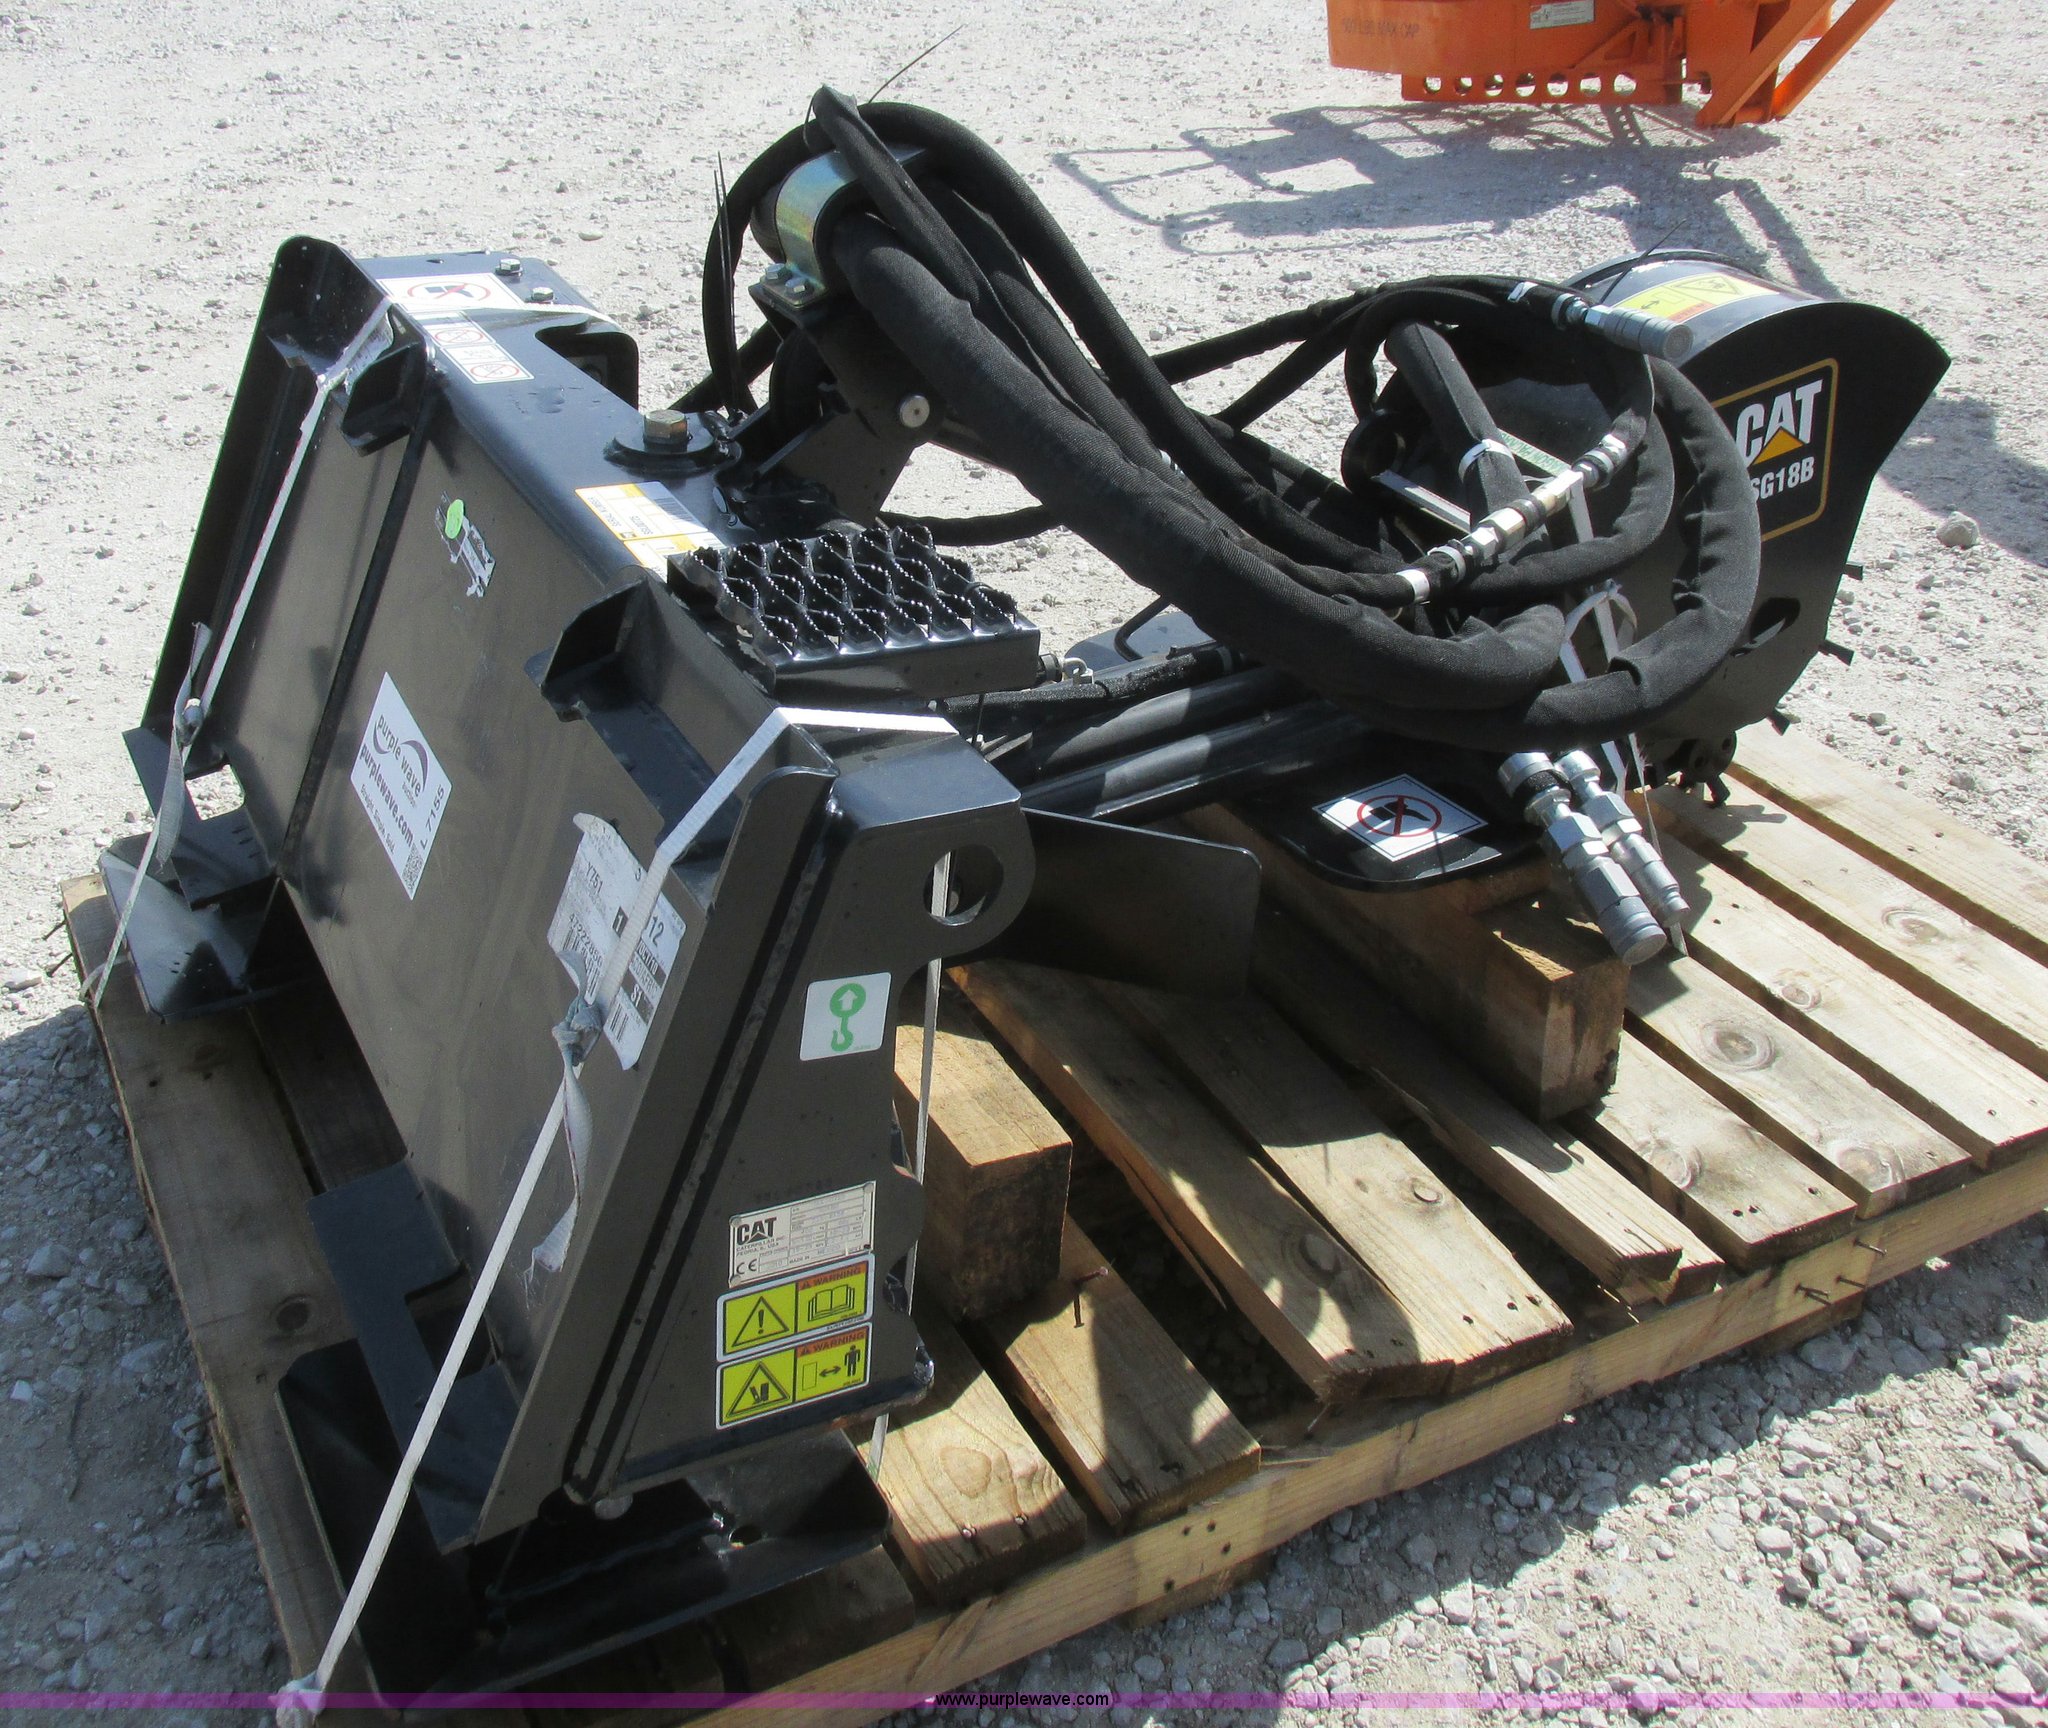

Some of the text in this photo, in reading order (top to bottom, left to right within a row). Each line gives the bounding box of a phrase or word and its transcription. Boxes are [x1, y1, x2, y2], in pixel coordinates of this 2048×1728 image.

[1736, 379, 1823, 468] CAT
[377, 715, 421, 797] purple wave
[359, 743, 414, 847] purplewave.com
[426, 784, 445, 832] 7155
[737, 1216, 777, 1246] CAT
[815, 1267, 860, 1284] WARNING
[815, 1332, 865, 1352] WARNING
